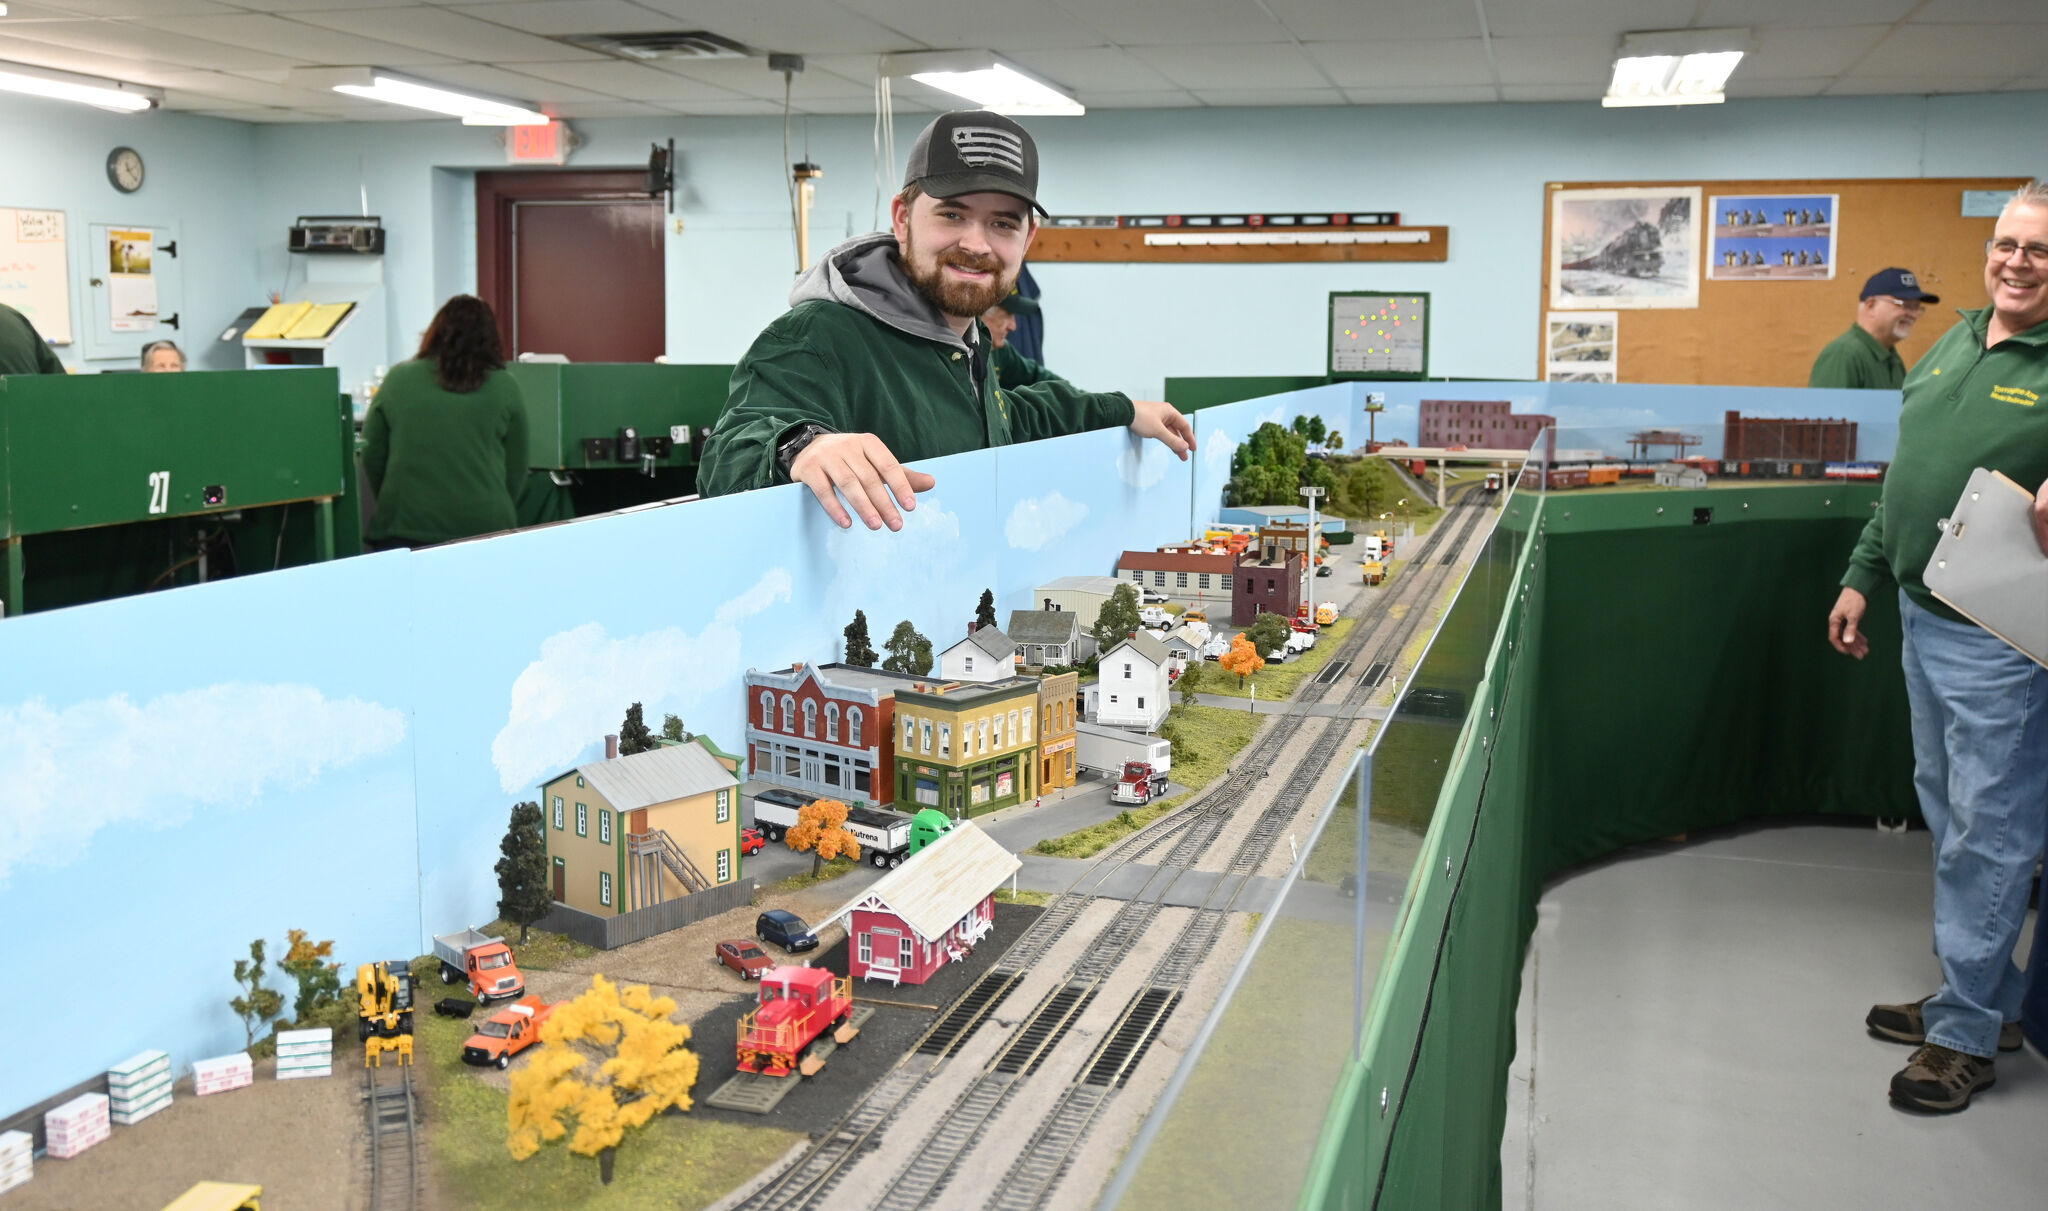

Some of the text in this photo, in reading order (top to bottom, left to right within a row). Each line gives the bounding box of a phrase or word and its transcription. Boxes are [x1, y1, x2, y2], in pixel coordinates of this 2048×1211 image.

[516, 125, 558, 157] EXIT
[671, 427, 686, 442] 91
[149, 471, 170, 514] 27
[850, 828, 879, 842] Nutrena
